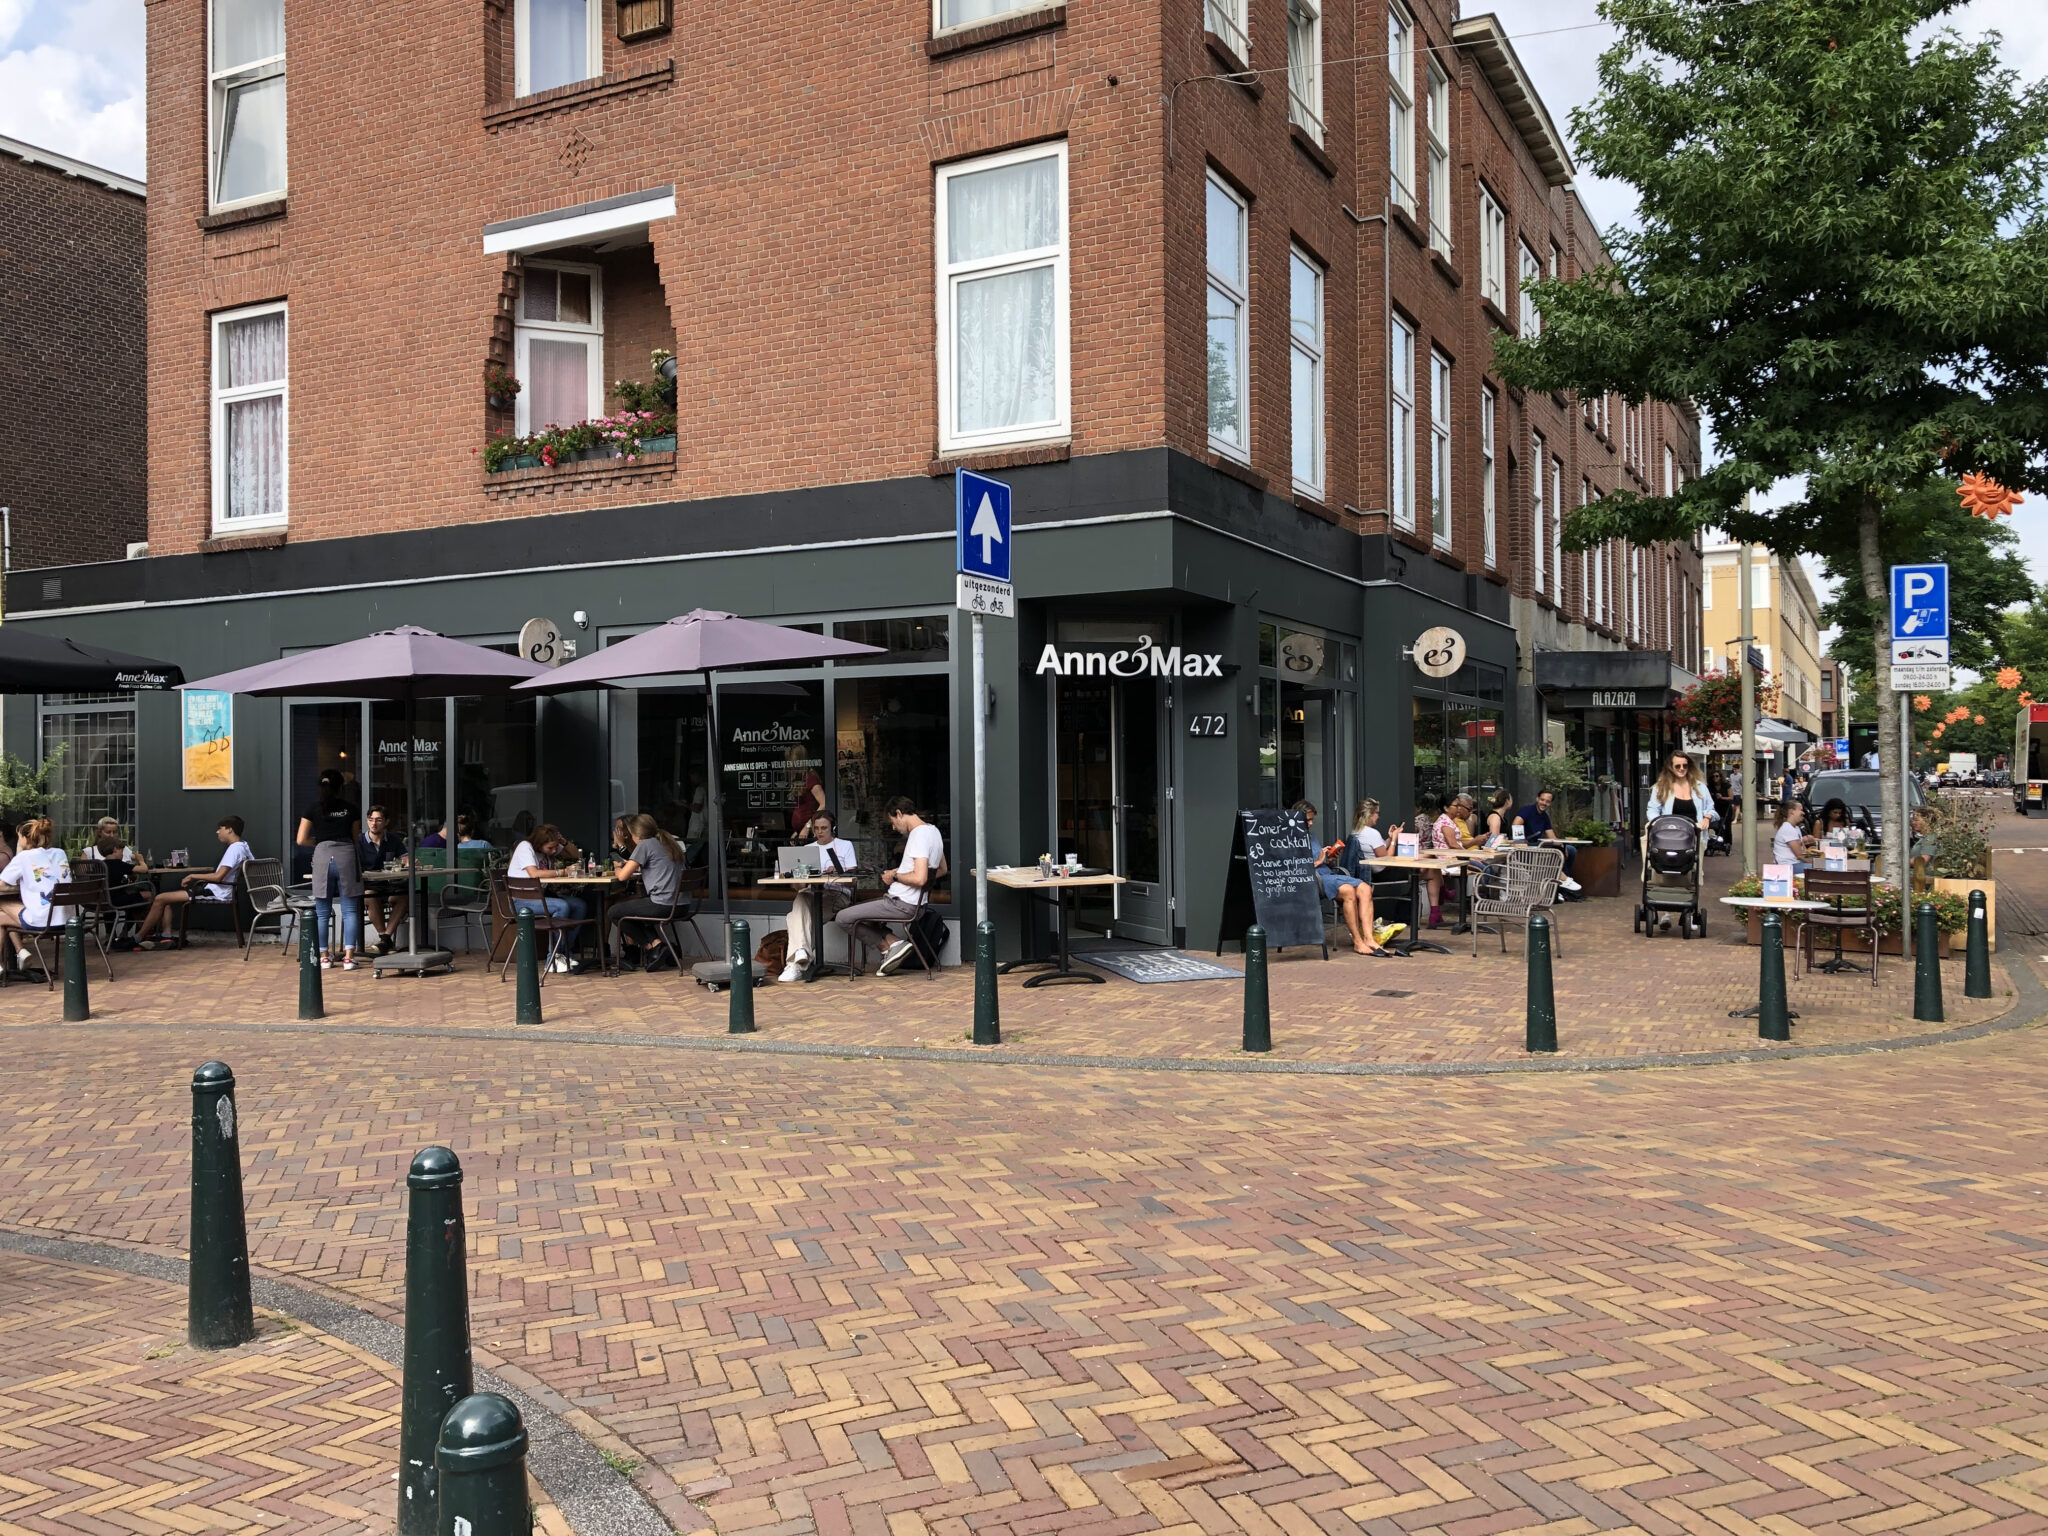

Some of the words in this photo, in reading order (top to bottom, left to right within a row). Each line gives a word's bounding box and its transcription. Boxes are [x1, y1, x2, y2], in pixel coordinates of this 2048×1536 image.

[964, 579, 1011, 596] uitgezonderd
[1904, 573, 1934, 608] P
[1592, 691, 1636, 706] ALAZAZA
[1190, 716, 1225, 735] 472
[1270, 834, 1311, 849] cocktail
[1249, 843, 1265, 859] €8
